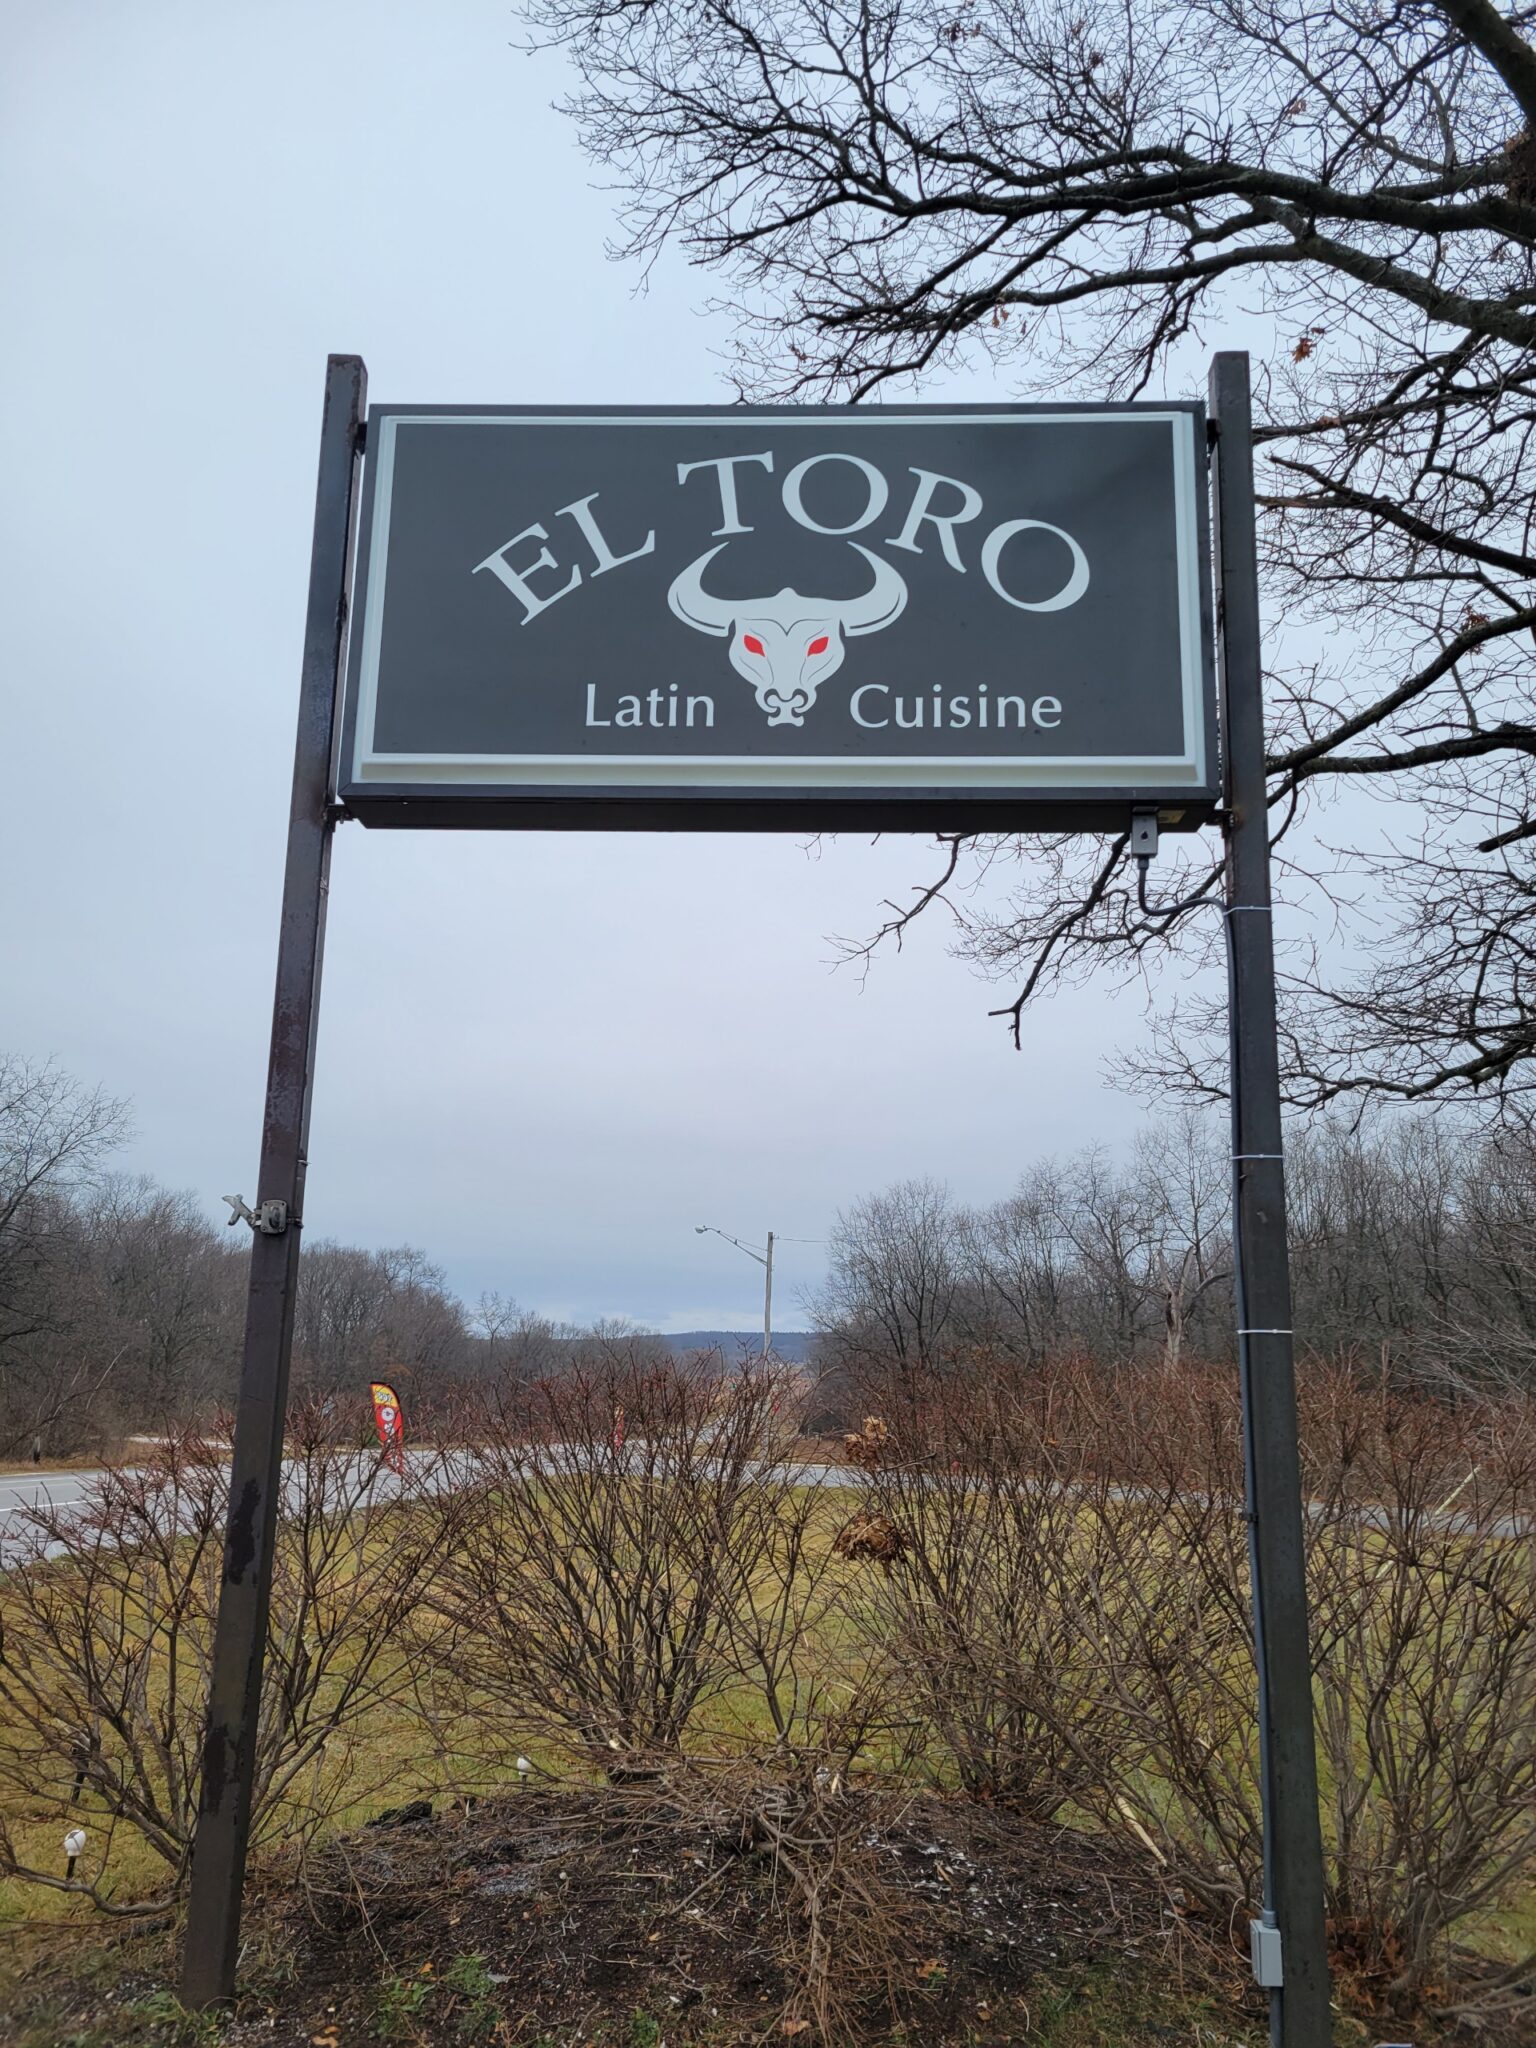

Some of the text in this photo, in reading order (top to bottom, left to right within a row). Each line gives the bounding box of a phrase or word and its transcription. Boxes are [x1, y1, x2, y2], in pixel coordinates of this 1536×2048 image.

[472, 451, 1090, 626] EL TORO
[585, 683, 1063, 729] Latin Cuisine
